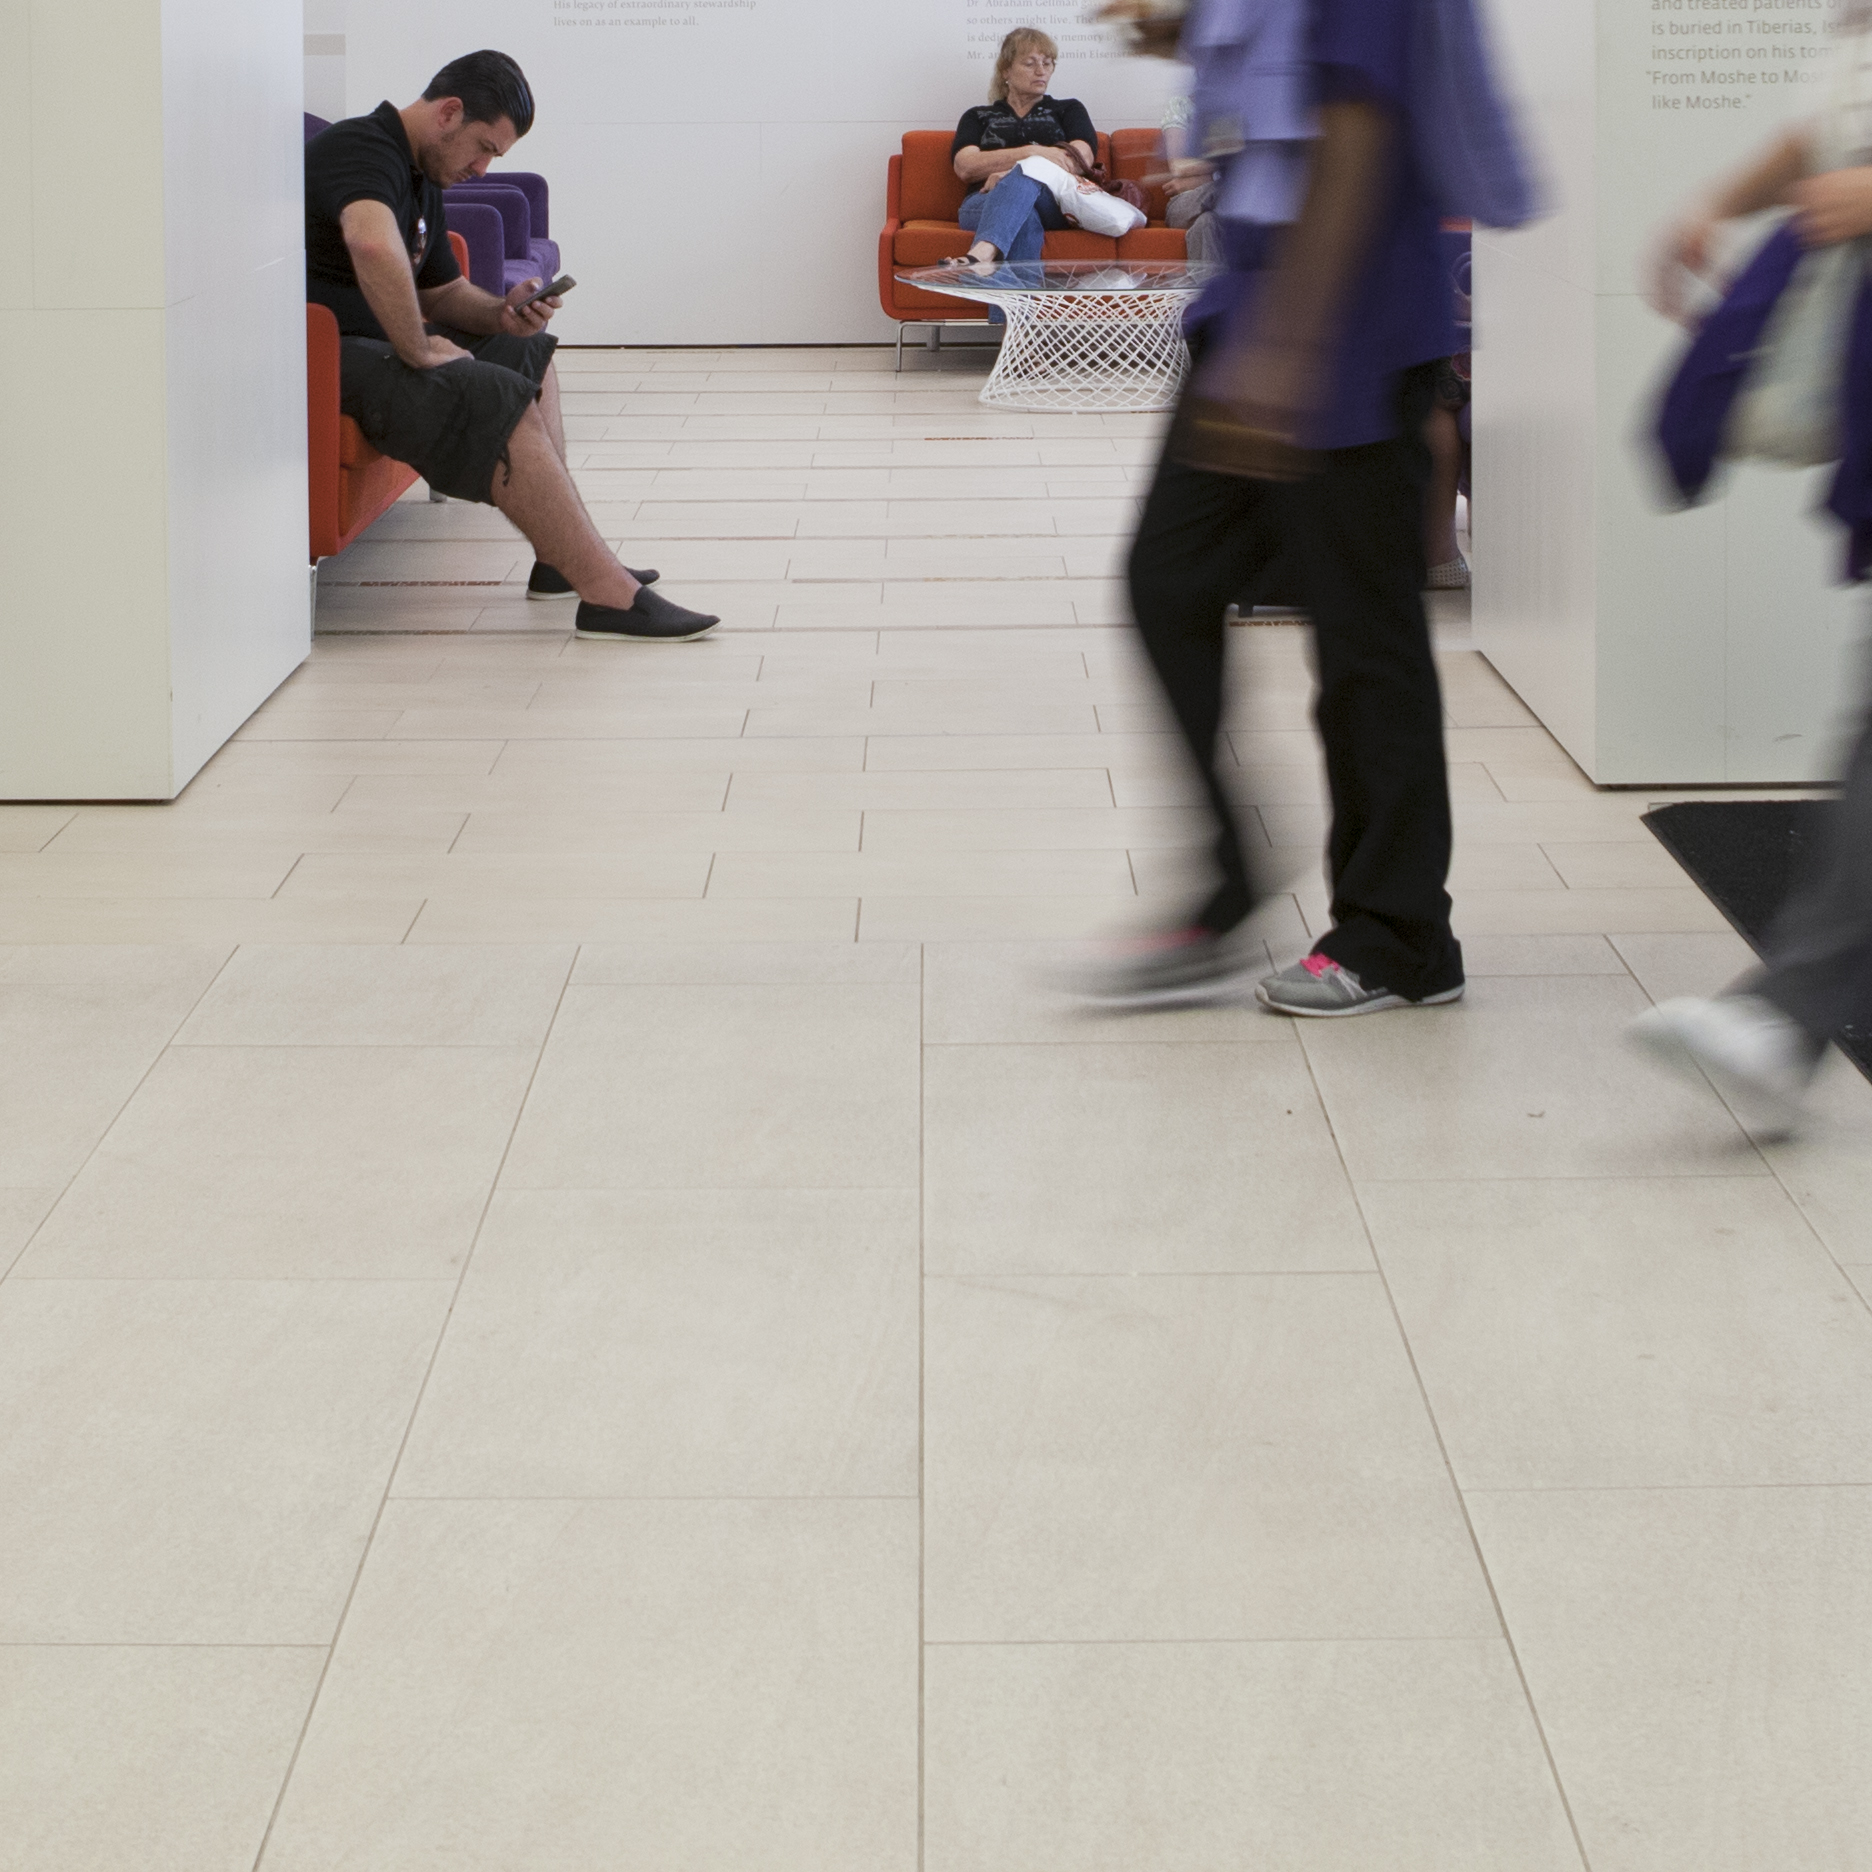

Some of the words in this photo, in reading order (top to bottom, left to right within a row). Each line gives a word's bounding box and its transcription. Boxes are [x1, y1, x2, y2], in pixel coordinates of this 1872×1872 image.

[553, 0, 571, 10] His
[607, 0, 618, 9] of
[553, 16, 578, 27] lives
[579, 18, 593, 27] on
[594, 18, 607, 27] as
[607, 18, 622, 27] an
[623, 16, 668, 29] example
[669, 18, 681, 26] to
[682, 16, 699, 27] all.
[966, 16, 978, 25] so
[979, 14, 1013, 25] others
[1015, 14, 1047, 28] might
[1074, 13, 1095, 25] The
[1651, 23, 1665, 36] is
[1669, 20, 1723, 36] buried
[1727, 21, 1744, 35] in
[1746, 19, 1818, 37] Tiberias,
[966, 32, 976, 43] is
[1061, 33, 1103, 43] memory
[966, 50, 985, 60] Mr.
[1652, 48, 1741, 62] inscription
[1746, 48, 1767, 59] on
[1771, 44, 1796, 59] his
[1700, 70, 1757, 85] Moshe
[1760, 71, 1780, 84] to
[1652, 94, 1681, 110] like
